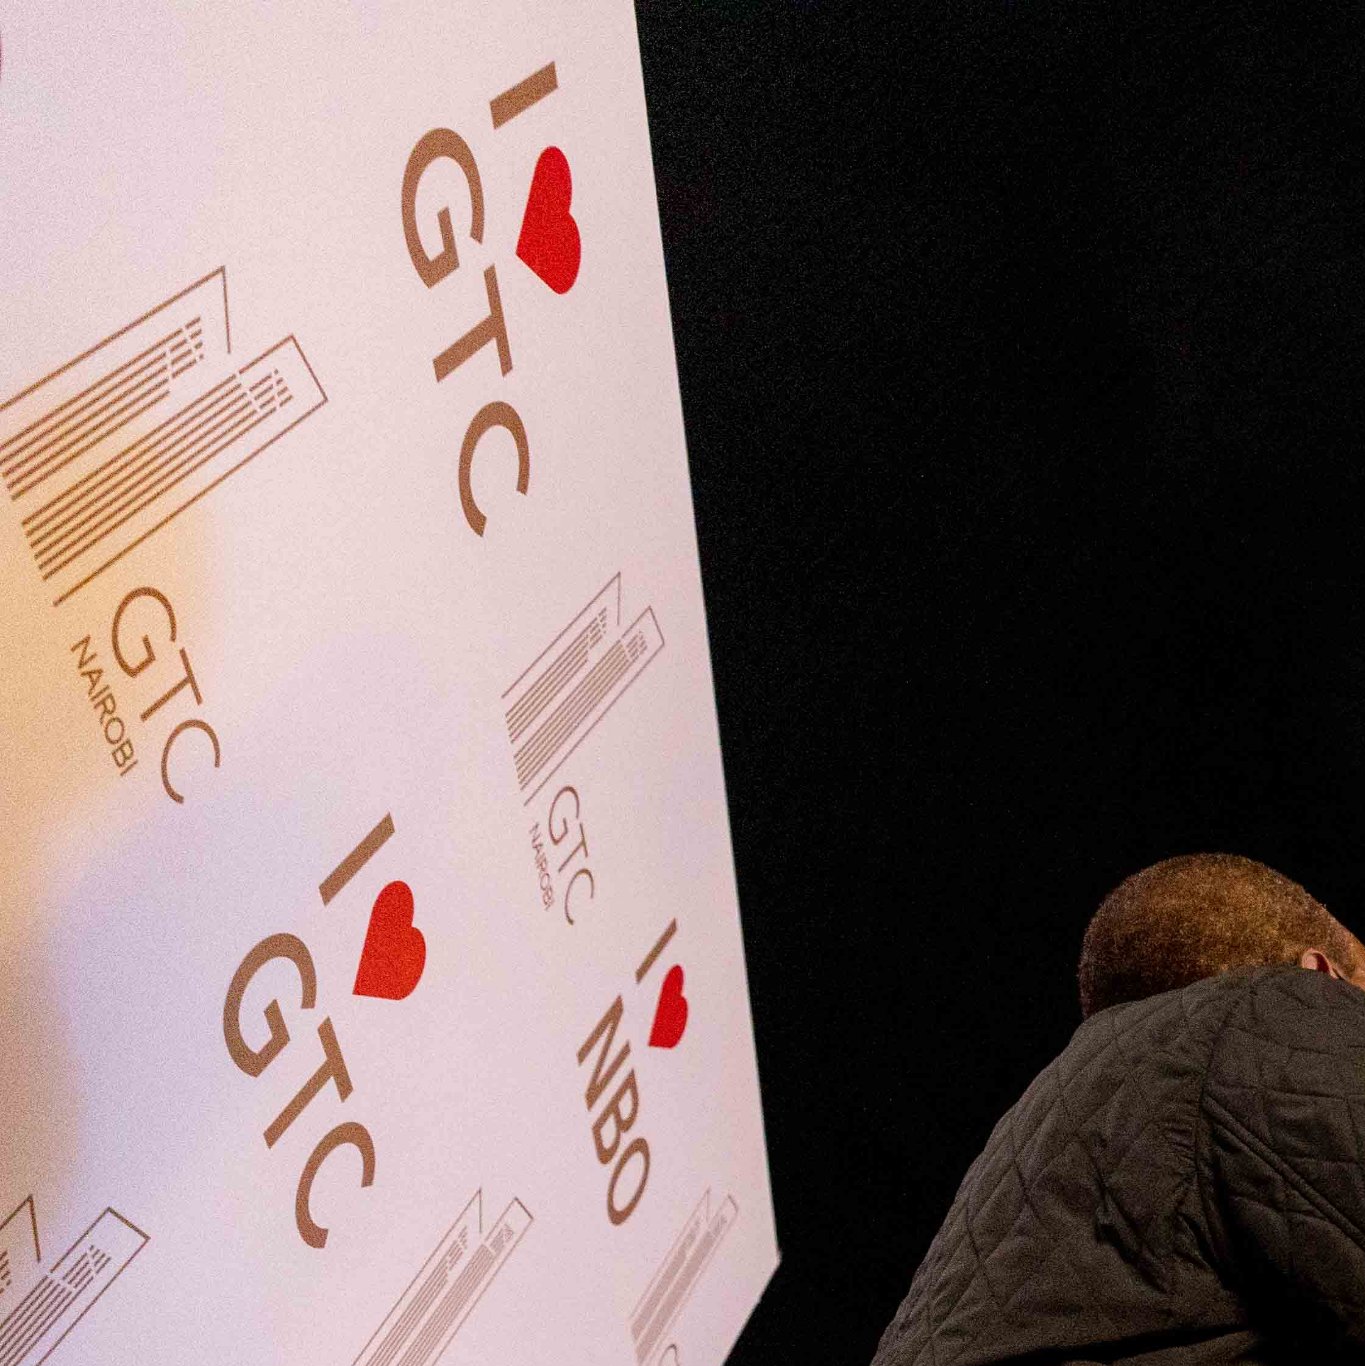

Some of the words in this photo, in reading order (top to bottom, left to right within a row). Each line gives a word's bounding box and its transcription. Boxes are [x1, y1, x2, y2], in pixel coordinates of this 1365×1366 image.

[490, 61, 559, 129] I
[402, 127, 531, 538] GTC
[70, 635, 138, 777] NAIROBI
[111, 586, 221, 804] GTC
[318, 813, 395, 906] I
[548, 785, 595, 926] GTC
[635, 918, 678, 984] I
[222, 932, 376, 1249] GTC
[576, 995, 651, 1227] NBO
